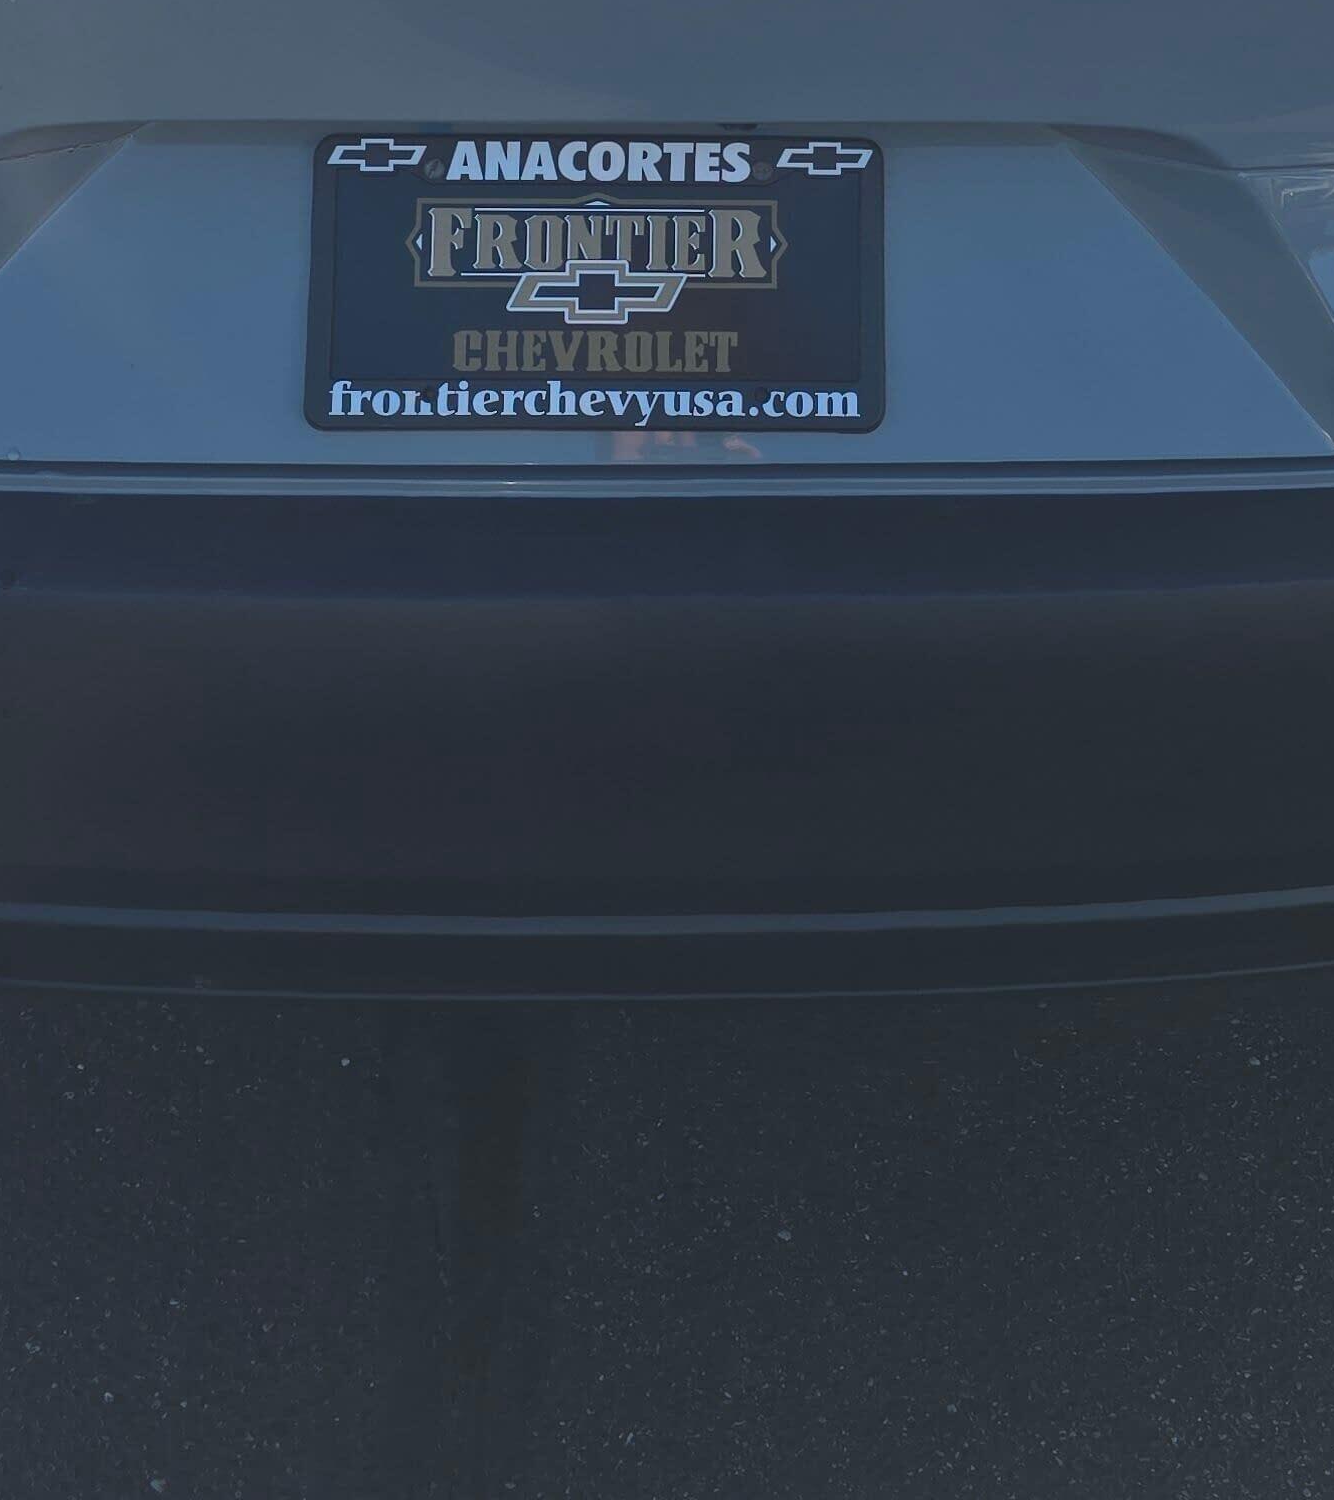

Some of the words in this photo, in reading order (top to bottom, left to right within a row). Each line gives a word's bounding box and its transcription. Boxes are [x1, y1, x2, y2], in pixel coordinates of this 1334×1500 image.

[445, 141, 752, 183] ANACORTES
[427, 206, 768, 278] FRONTIER
[452, 329, 739, 373] CHEVROLET
[328, 379, 861, 427] frontierchevyusa.com
